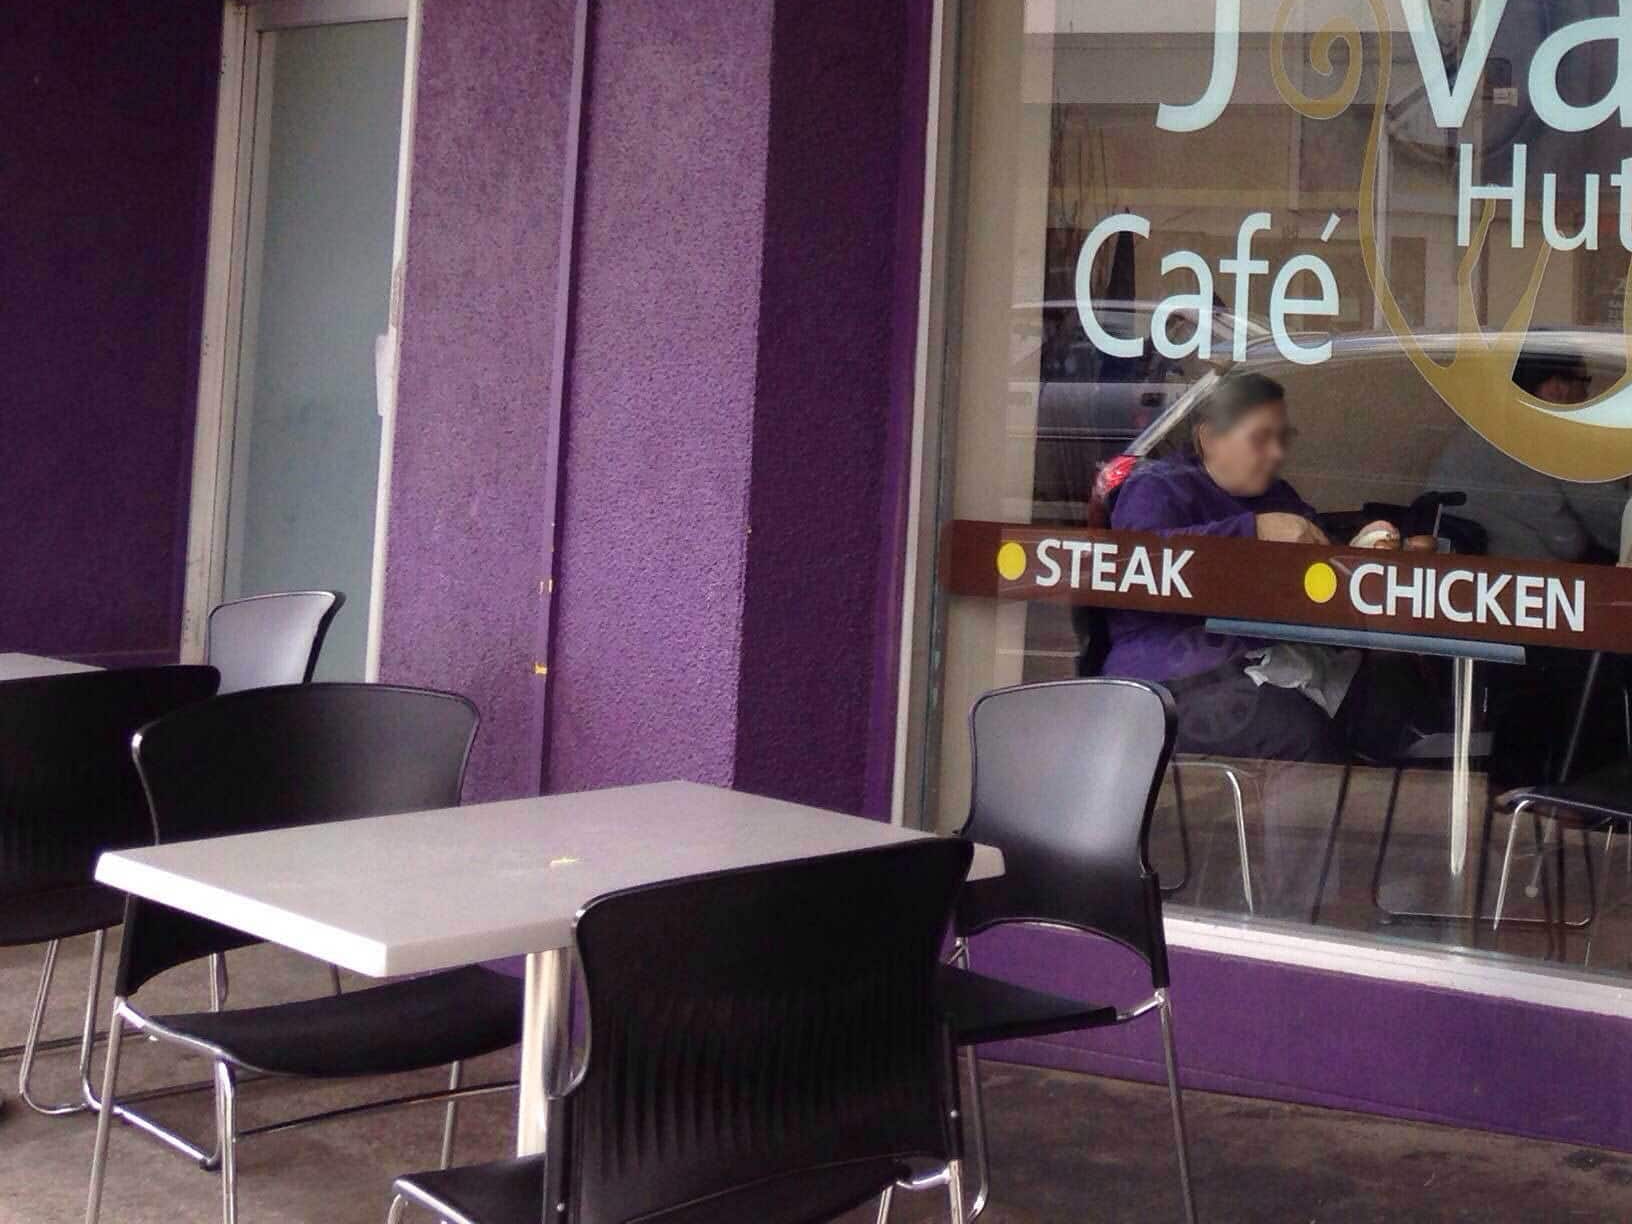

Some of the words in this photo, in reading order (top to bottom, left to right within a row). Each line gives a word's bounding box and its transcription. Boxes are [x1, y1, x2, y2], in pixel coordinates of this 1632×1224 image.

[1074, 212, 1341, 365] Café
[1035, 537, 1195, 599] STEAK
[1349, 562, 1585, 632] CHICKEN
